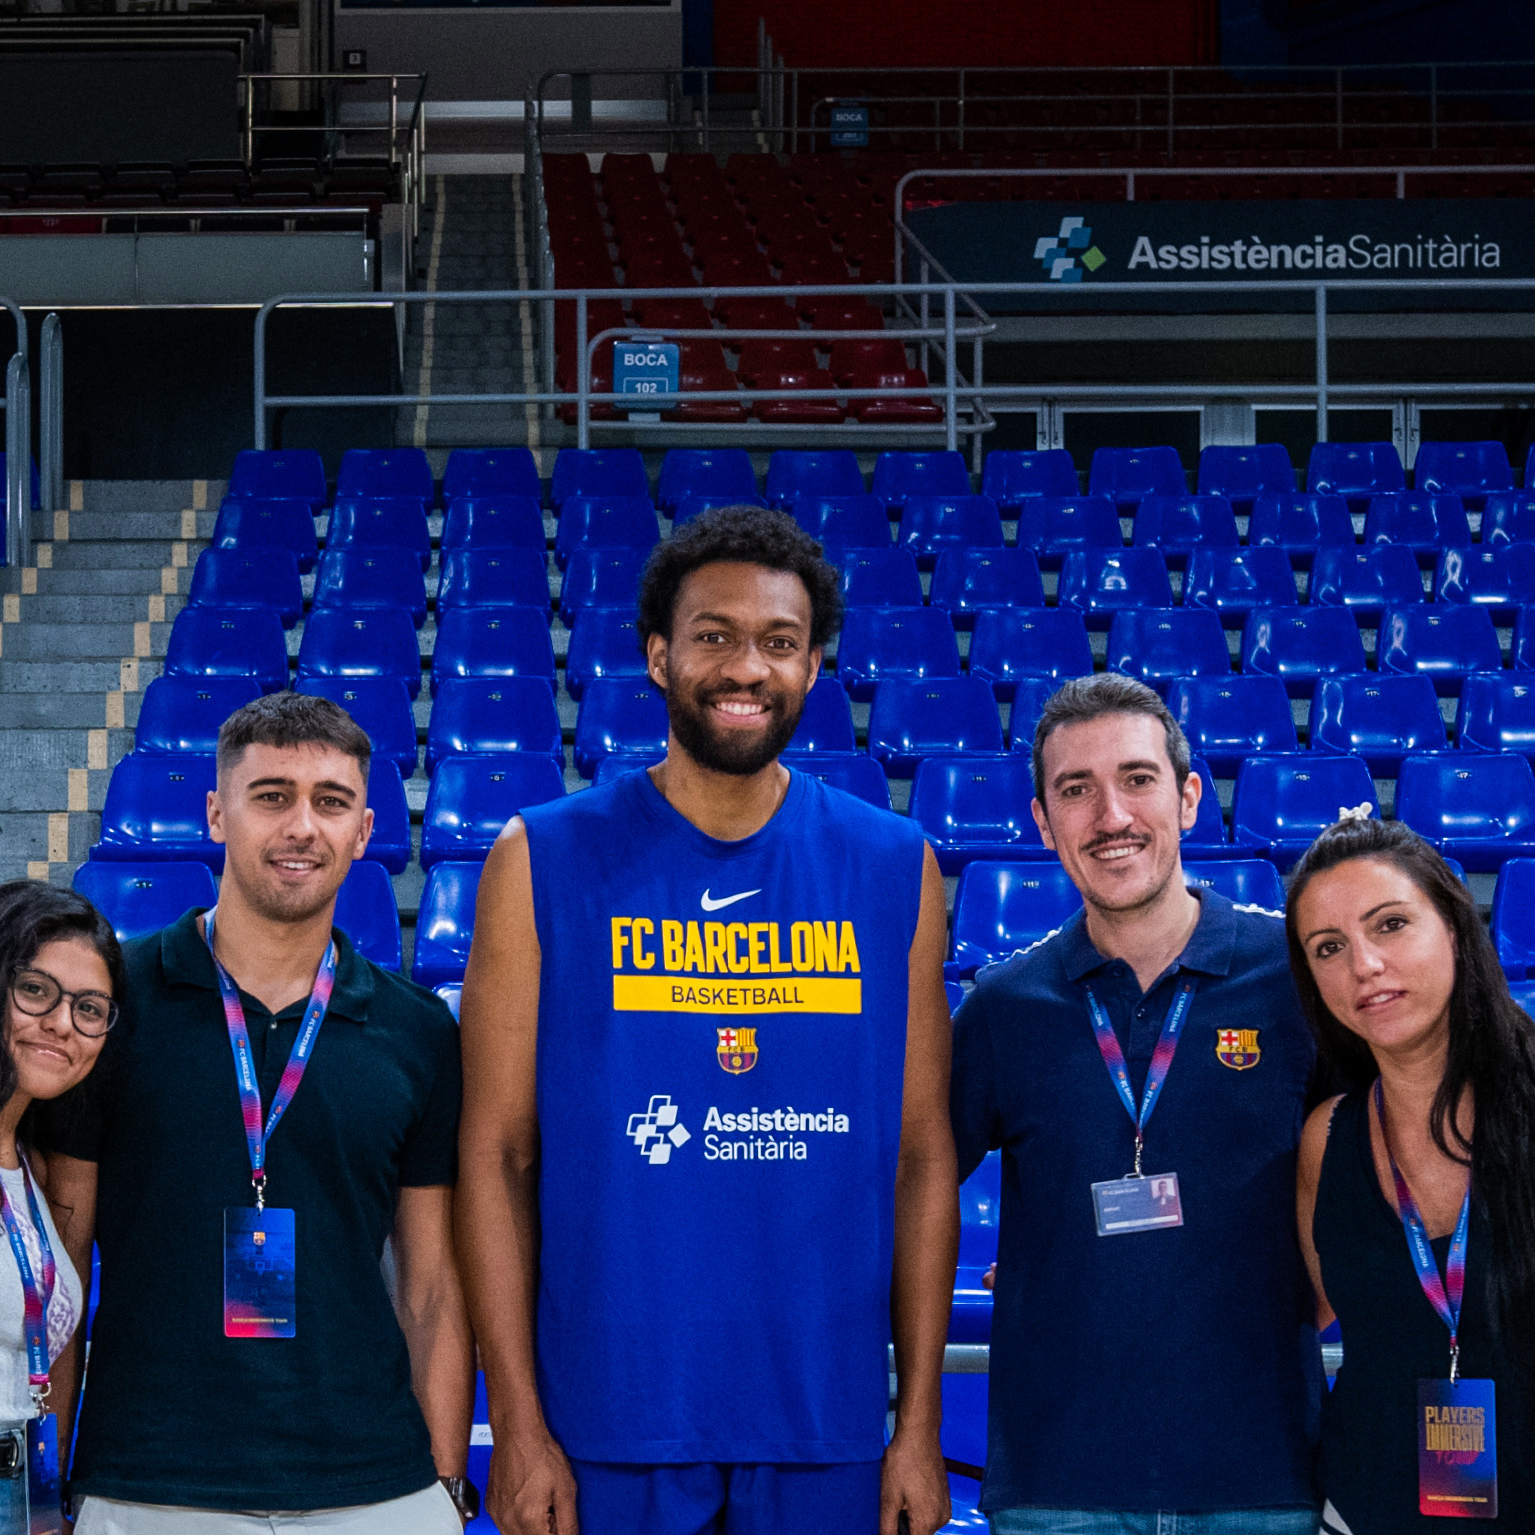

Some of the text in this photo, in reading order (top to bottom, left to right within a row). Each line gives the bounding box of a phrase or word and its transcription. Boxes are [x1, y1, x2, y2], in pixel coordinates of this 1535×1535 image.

[836, 113, 863, 121] BOCA
[623, 355, 668, 367] BOCA
[635, 383, 657, 393] 102
[611, 917, 861, 973] FC BARCELONA
[671, 985, 804, 1005] BASKETBALL
[703, 1106, 850, 1133] Assistència
[703, 1135, 808, 1160] Sanitària
[1425, 1406, 1485, 1424] PLAYERS
[1426, 1423, 1485, 1452] IMMERSIVE
